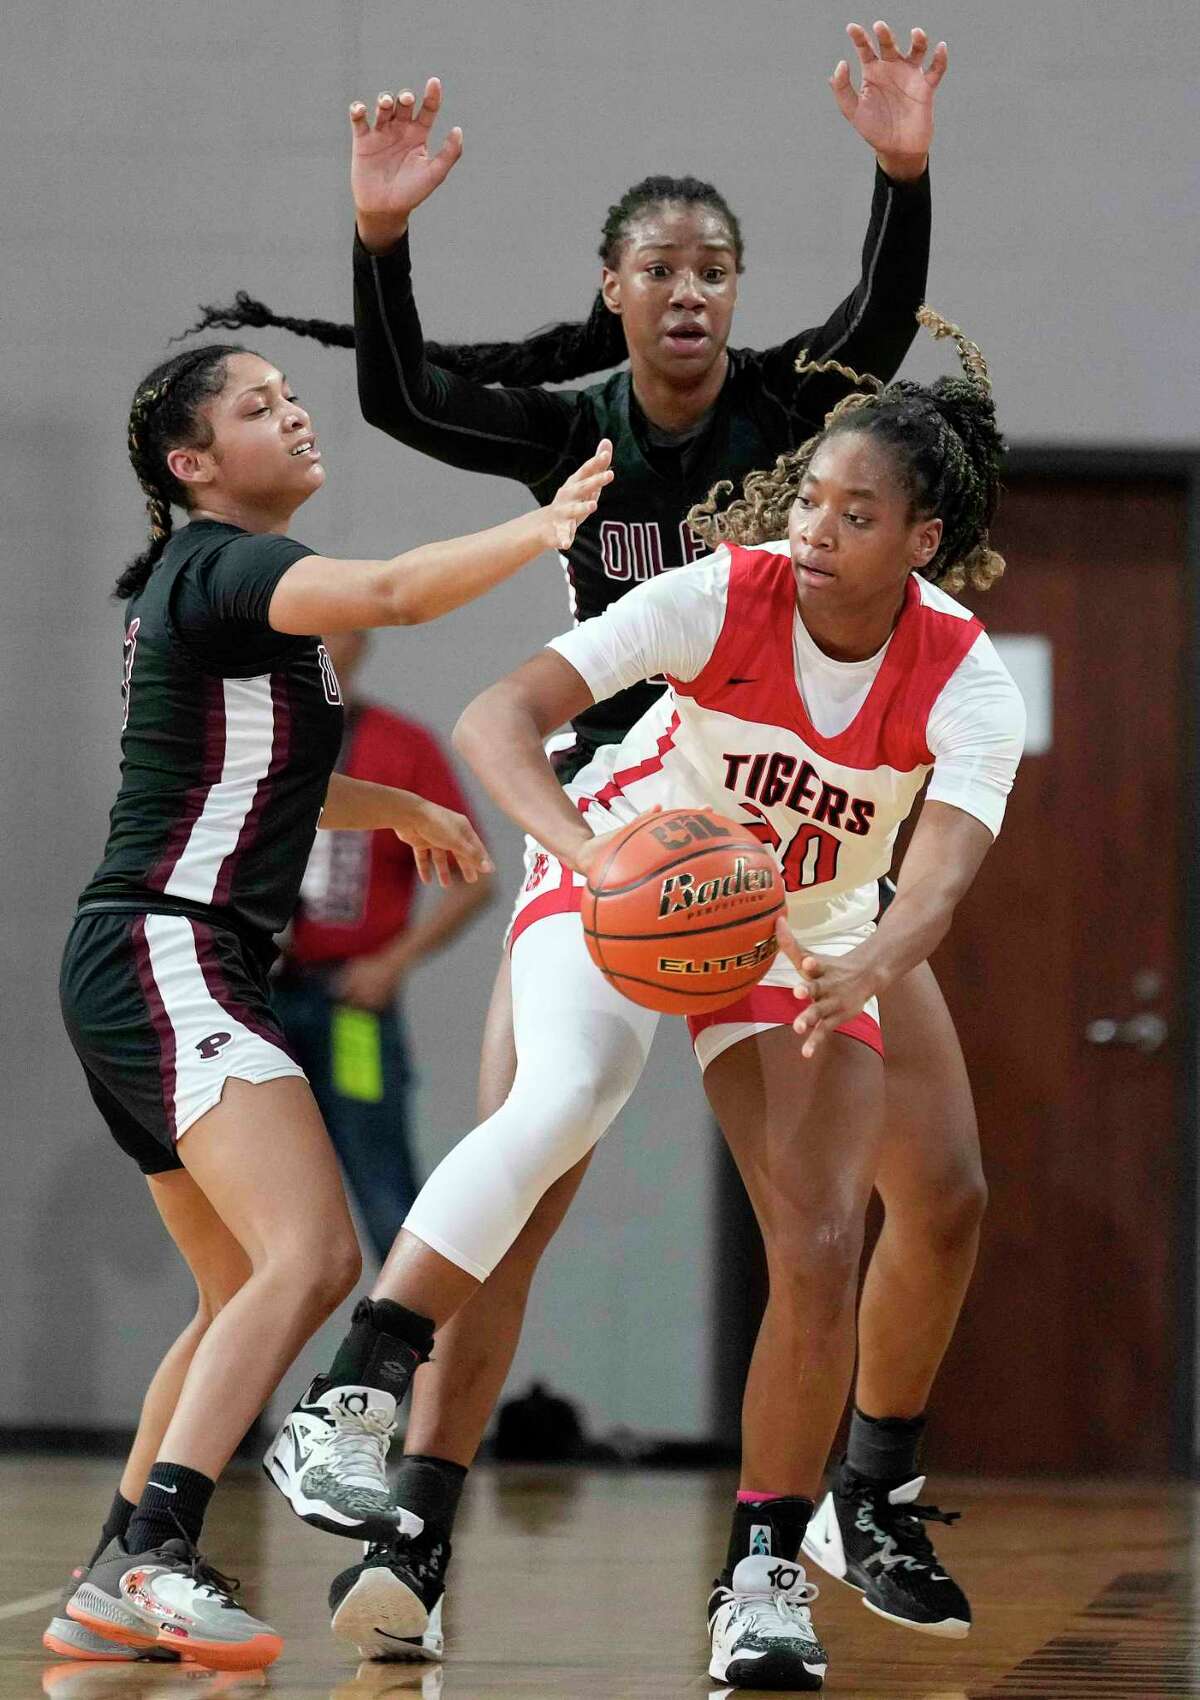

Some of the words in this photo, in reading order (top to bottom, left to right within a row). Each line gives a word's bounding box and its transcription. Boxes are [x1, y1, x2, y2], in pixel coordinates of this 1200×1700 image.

[601, 512, 727, 581] OILE
[722, 751, 875, 836] TIGERS
[656, 855, 774, 920] Baden
[657, 949, 755, 975] ELITE
[194, 1031, 232, 1060] P
